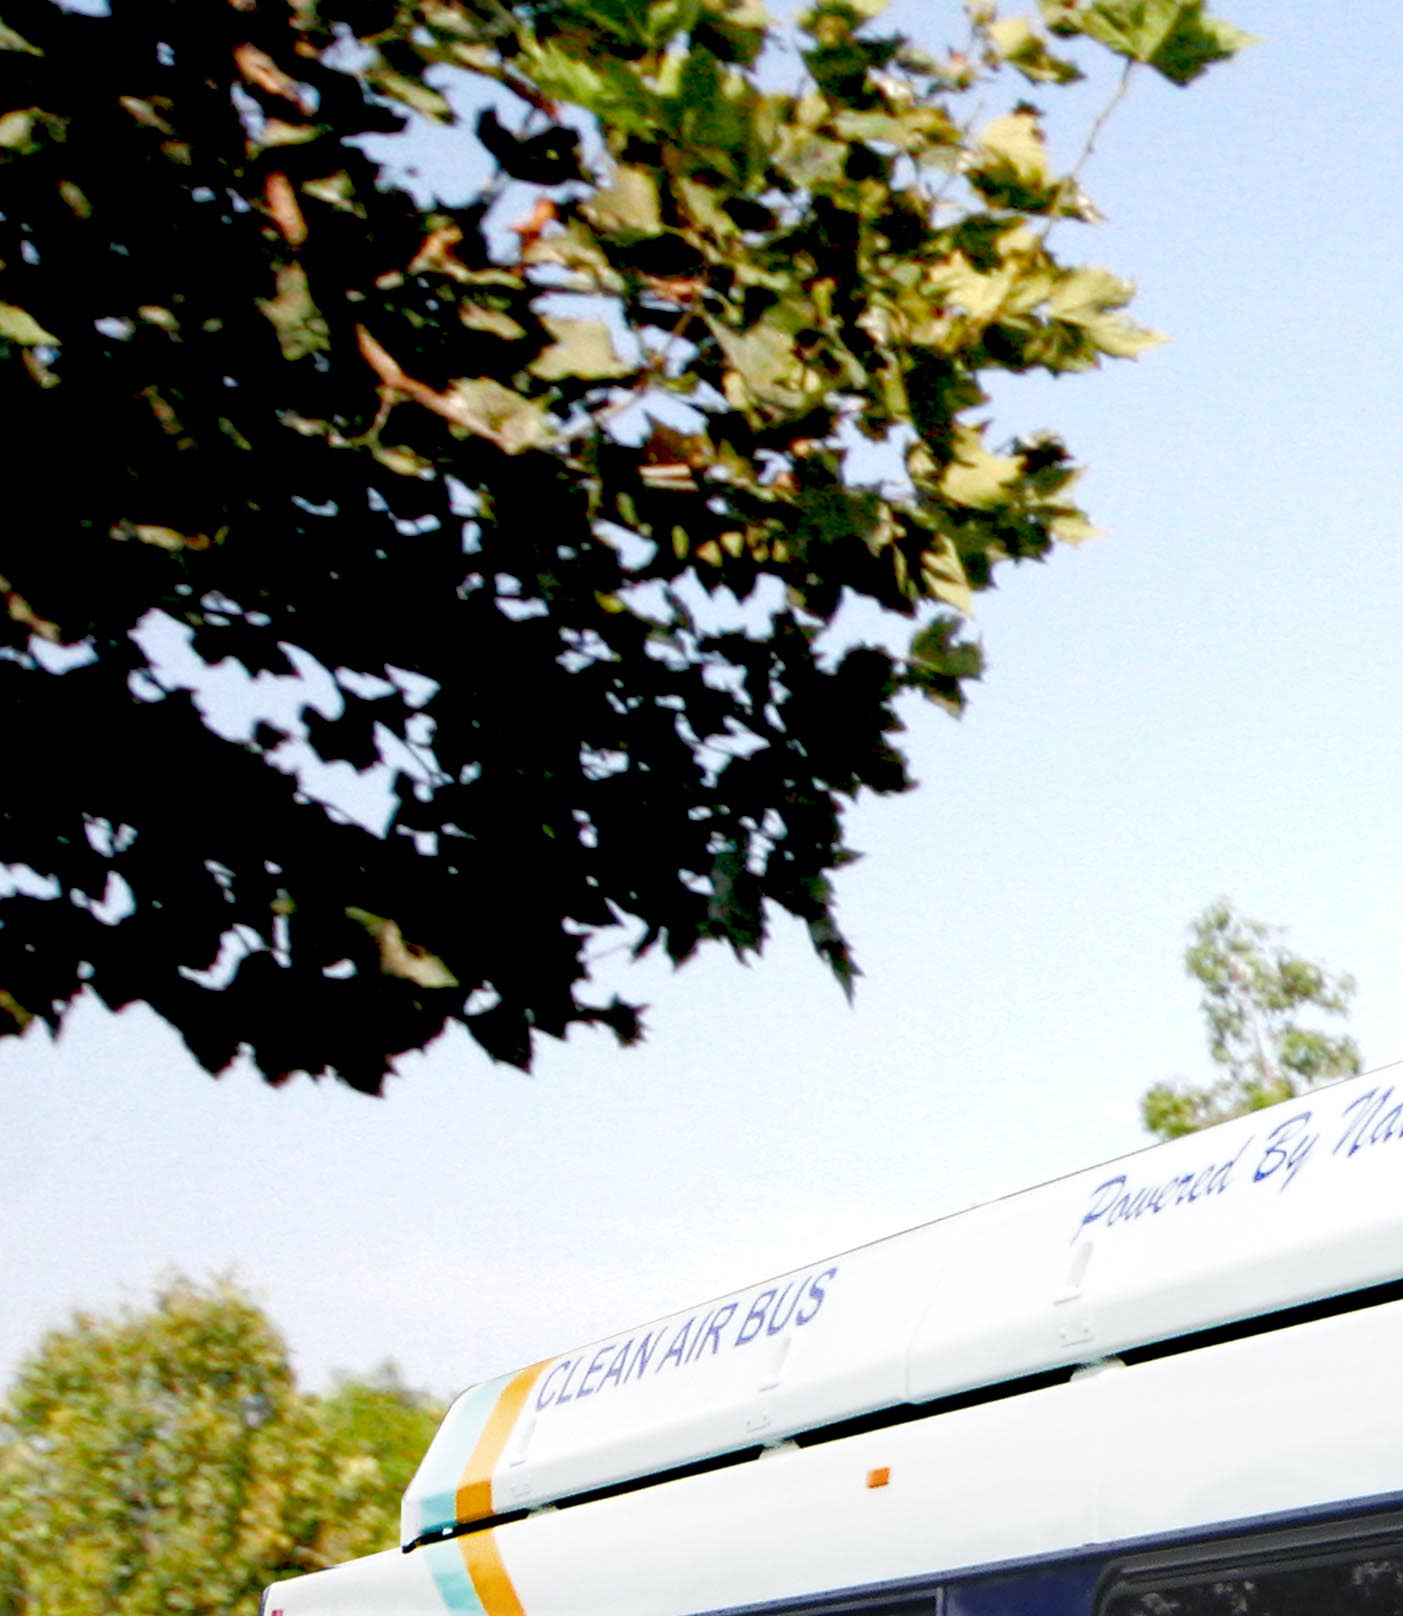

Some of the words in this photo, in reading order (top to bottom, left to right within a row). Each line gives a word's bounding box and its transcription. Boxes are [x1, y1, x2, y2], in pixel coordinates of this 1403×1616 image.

[1070, 1136, 1255, 1244] Powered
[1253, 1111, 1320, 1192] By
[536, 1326, 669, 1411] CLEAN
[656, 1302, 739, 1374] AIR
[734, 1266, 838, 1348] BUS
